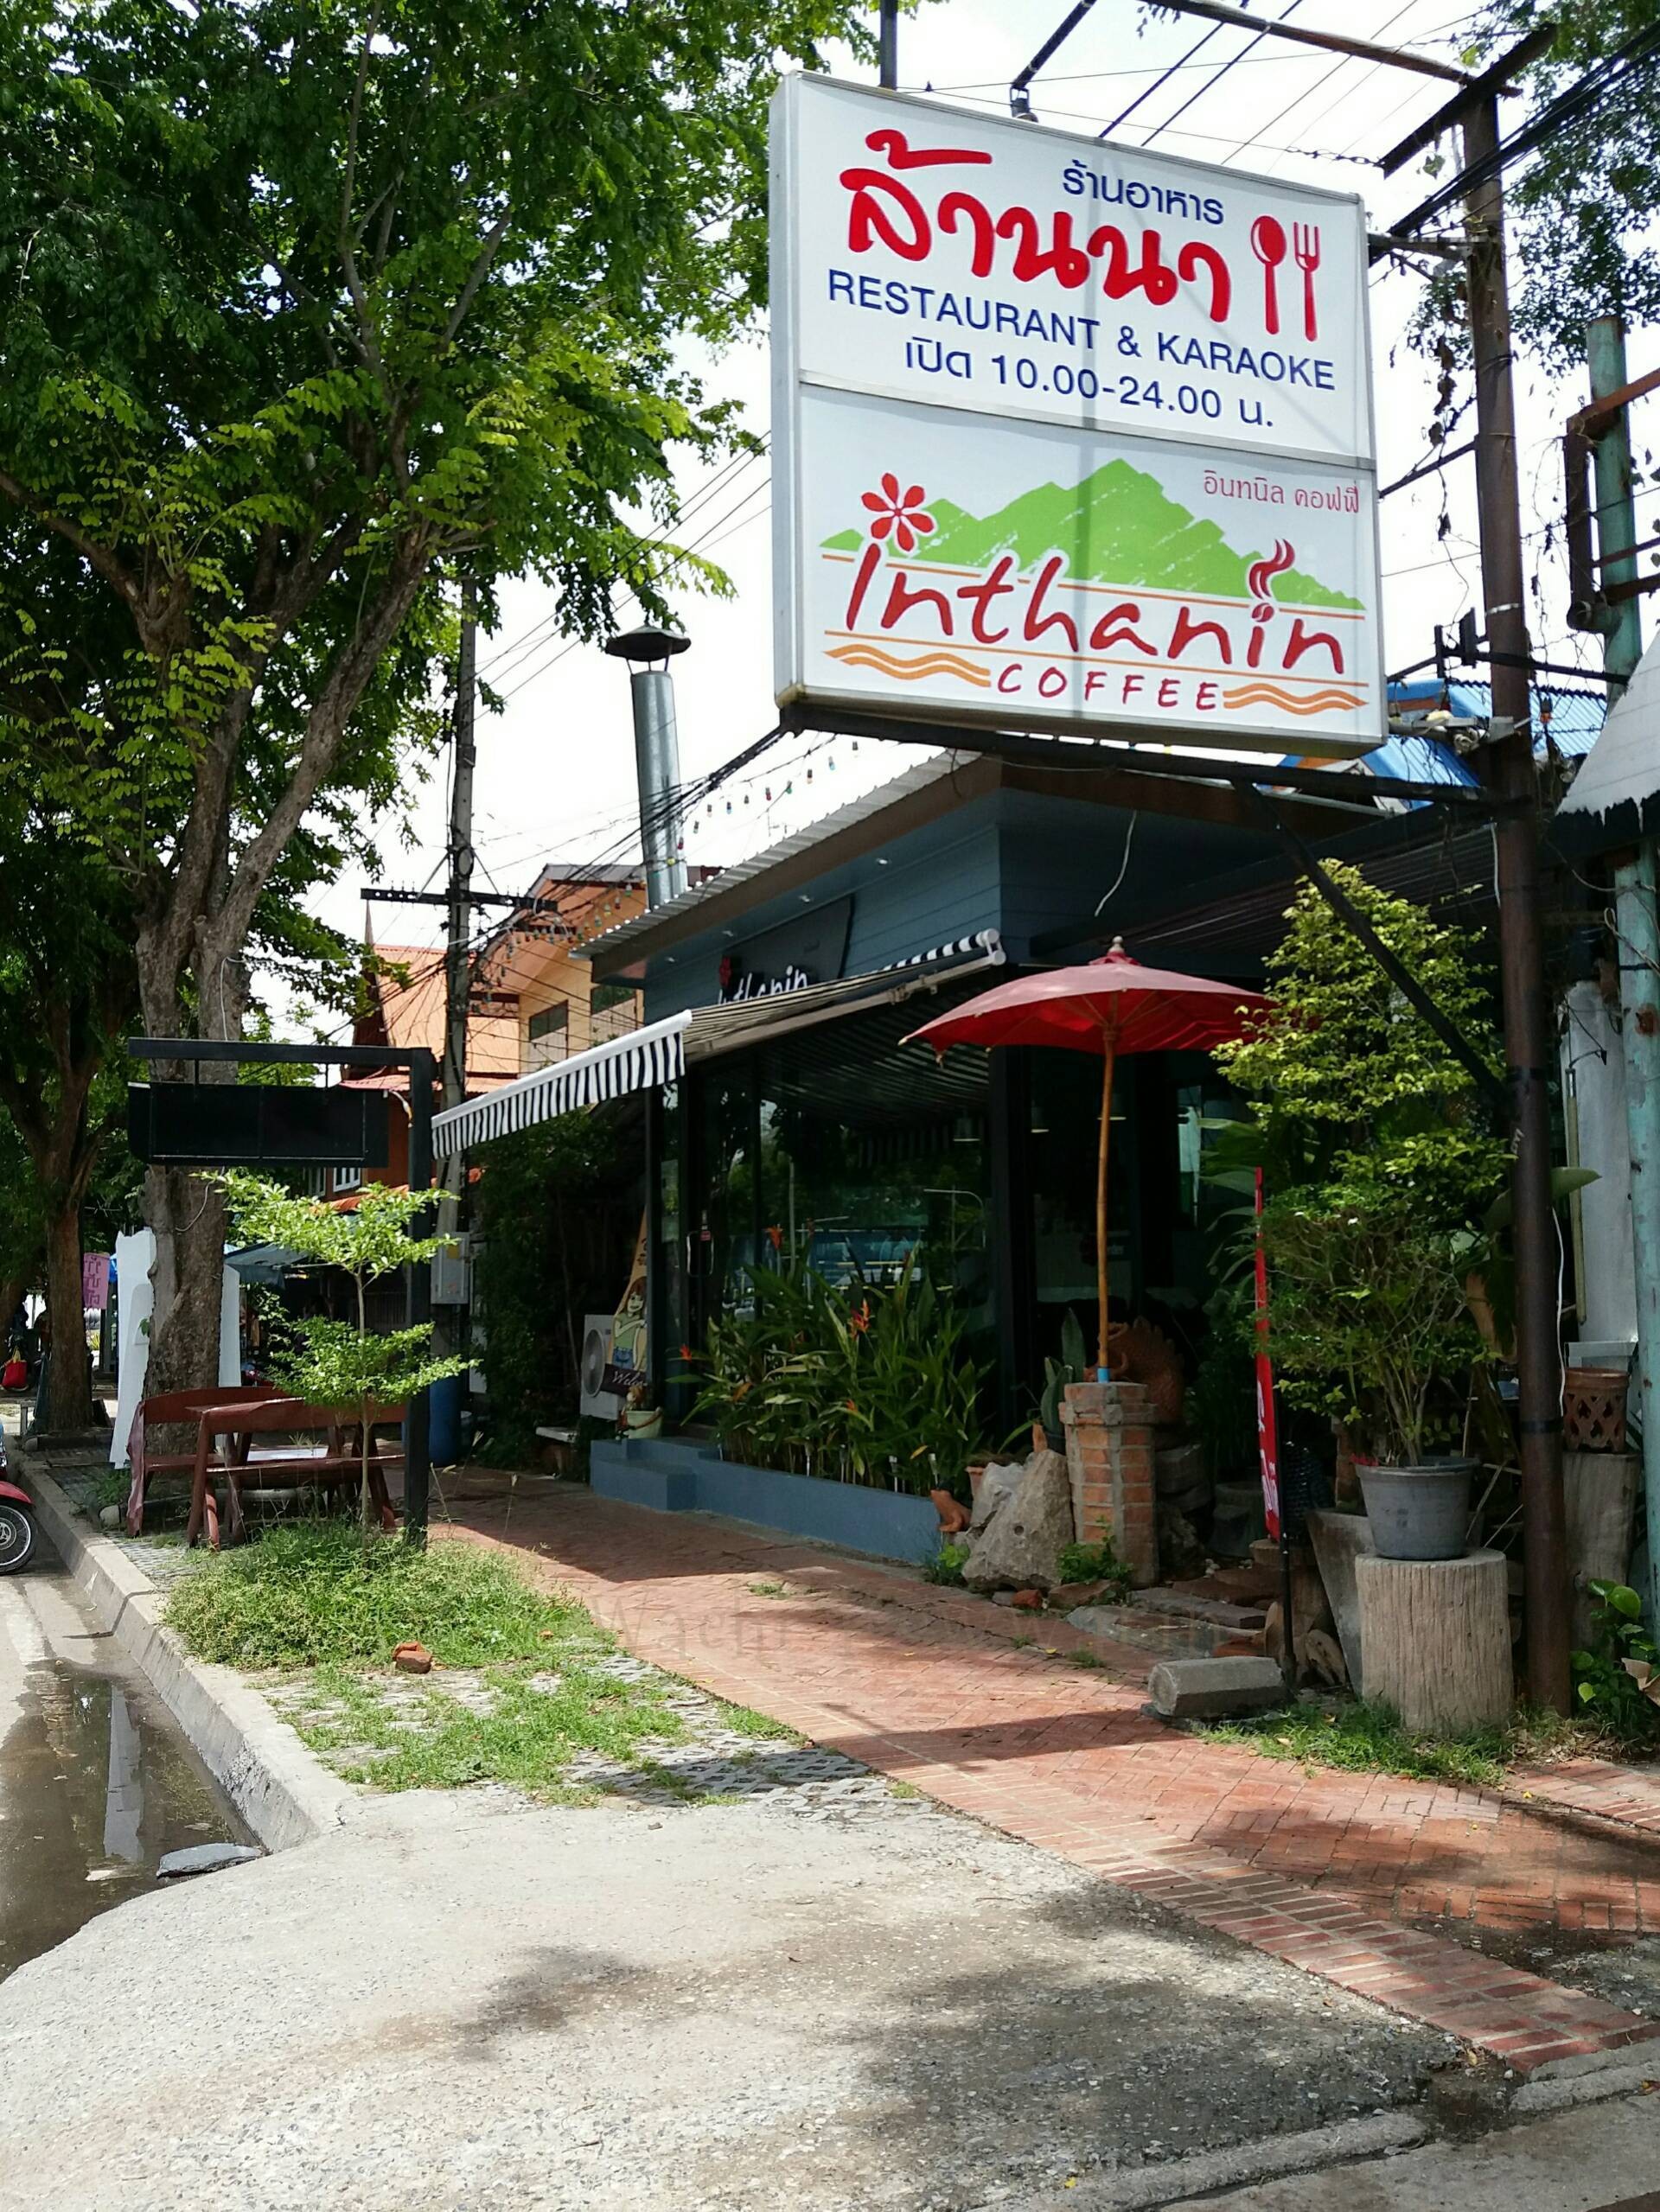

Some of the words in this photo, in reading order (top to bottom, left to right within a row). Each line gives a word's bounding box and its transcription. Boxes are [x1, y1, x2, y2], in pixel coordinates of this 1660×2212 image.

[839, 129, 1231, 323] ล้านนา
[1063, 158, 1224, 226] ร้านอาหาร
[829, 268, 1101, 350] RESTAURANT
[1117, 325, 1141, 357] &
[1158, 331, 1336, 391] KARAOKE
[905, 336, 973, 379] เปิด
[992, 354, 1221, 418] 10.00-24.00
[1239, 399, 1274, 426] น.
[1204, 469, 1284, 504] อินทนิล
[846, 543, 1344, 673] Inthanin
[997, 663, 1224, 710] COFFEE
